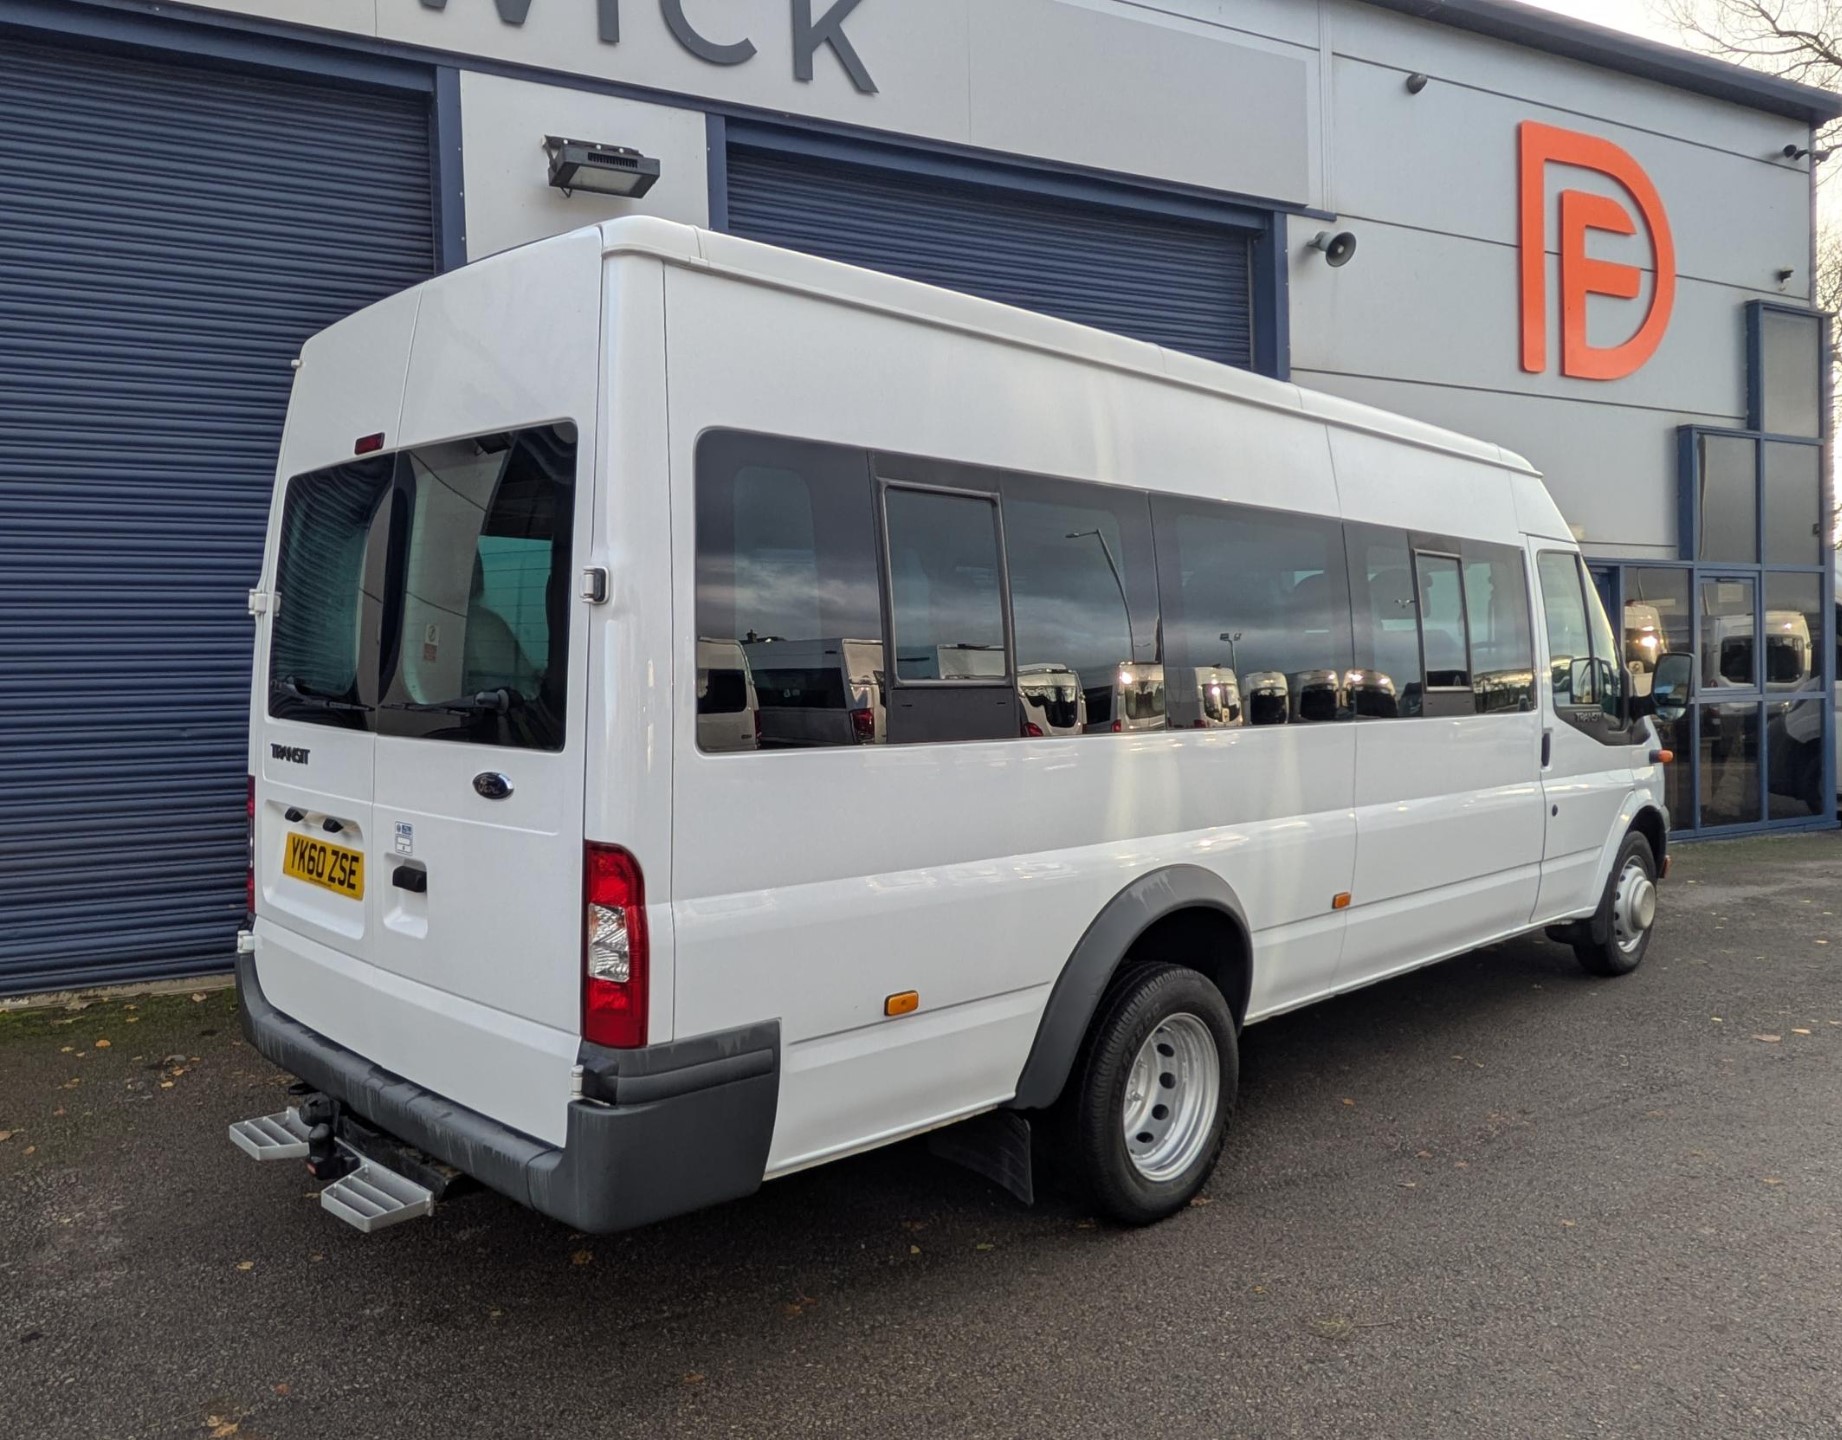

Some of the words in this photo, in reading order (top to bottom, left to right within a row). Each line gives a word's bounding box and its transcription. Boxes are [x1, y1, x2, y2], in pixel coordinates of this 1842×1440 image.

[270, 743, 310, 765] TRANSIT
[291, 837, 327, 879] YK60
[328, 849, 360, 890] ZSE
